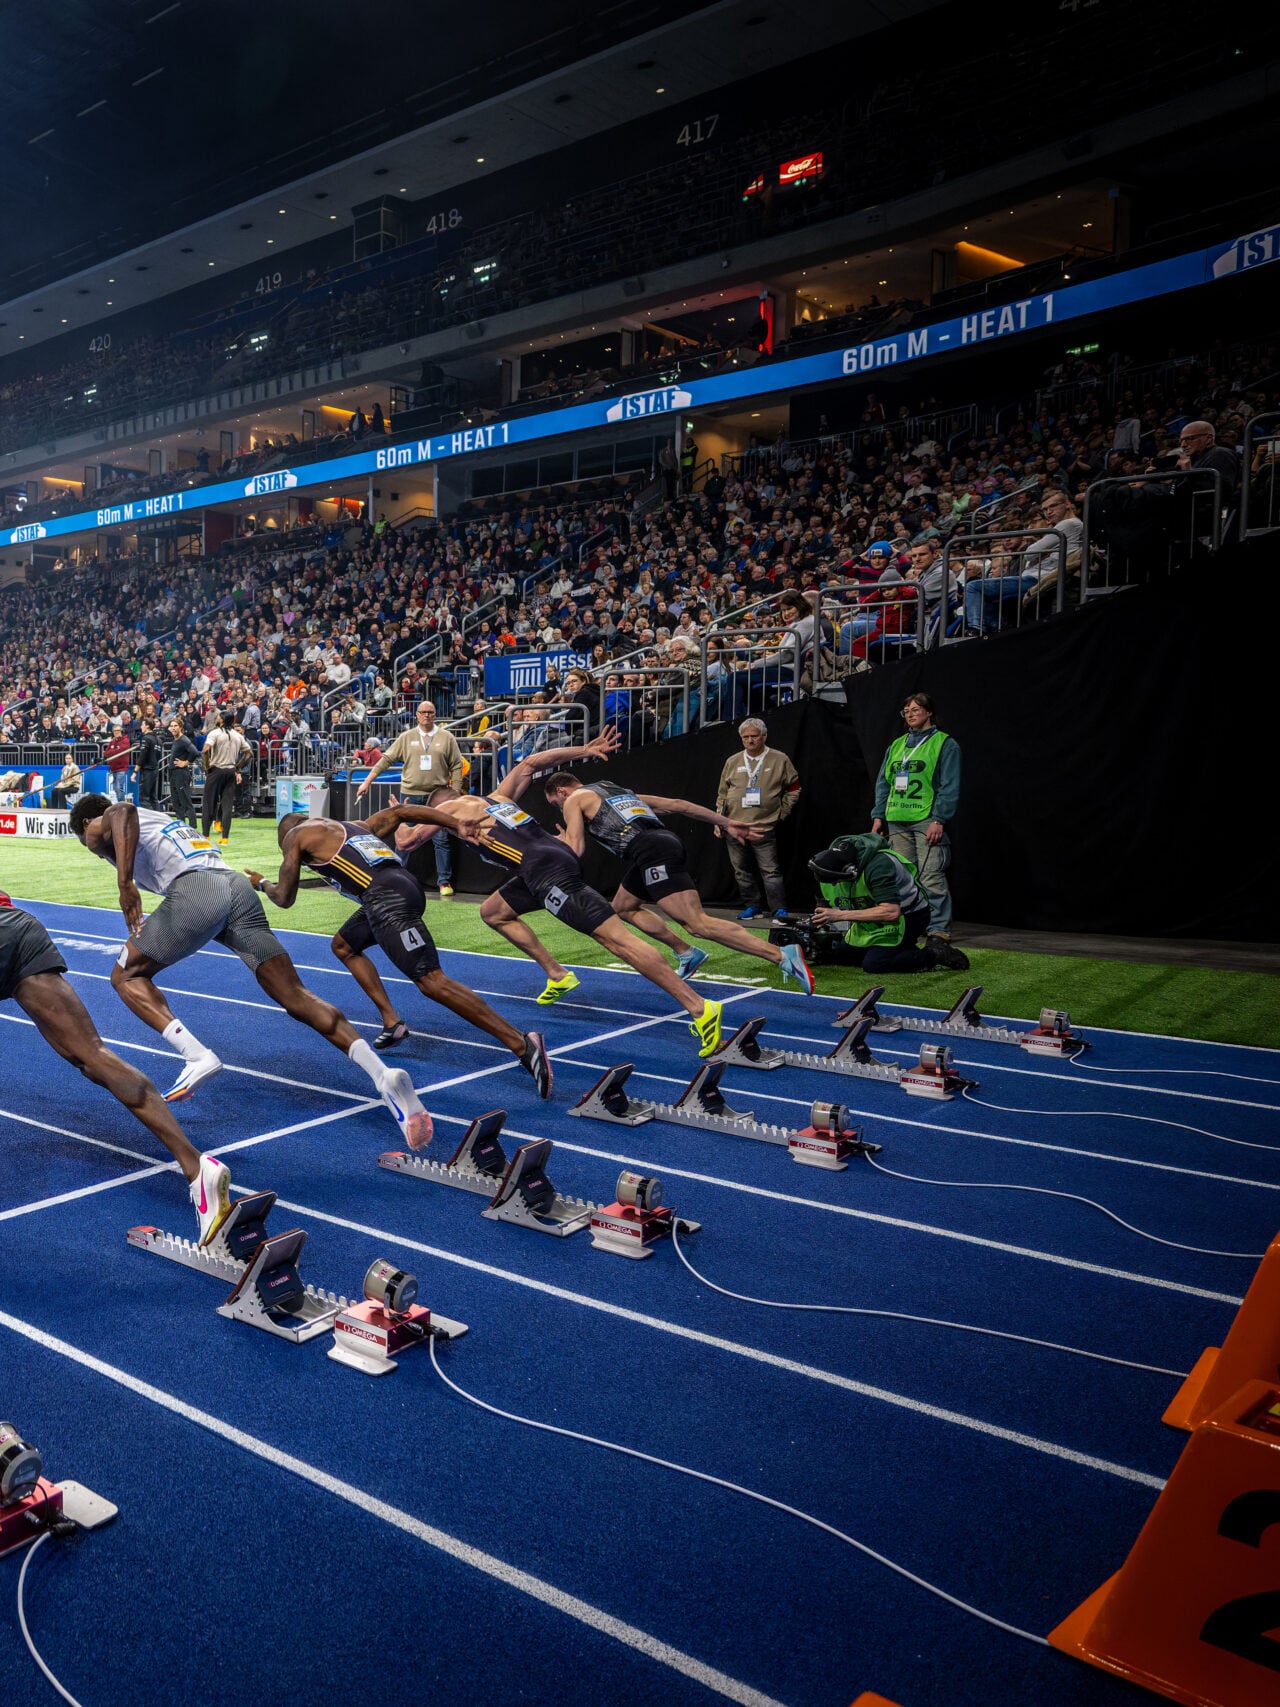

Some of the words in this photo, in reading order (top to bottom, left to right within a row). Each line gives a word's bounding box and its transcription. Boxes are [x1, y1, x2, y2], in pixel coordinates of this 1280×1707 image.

[676, 113, 720, 148] 417
[426, 208, 460, 236] 418
[254, 271, 283, 295] 419
[88, 332, 112, 353] 420
[842, 341, 898, 375] 60m
[907, 329, 928, 359] M
[961, 301, 1032, 345] HEAT
[1043, 294, 1055, 322] 1
[621, 388, 676, 420] ISTAF
[376, 446, 412, 470] 60m
[417, 440, 431, 462] M
[451, 426, 495, 455] HEAT
[501, 422, 510, 444] 1
[253, 472, 289, 495] ISTAF
[96, 508, 121, 527] 60m
[124, 504, 133, 520] M
[145, 495, 174, 516] HEAT
[177, 493, 183, 510] 1
[16, 524, 40, 542] ISTAF
[25, 816, 45, 835] Wir
[650, 868, 660, 881] 6
[548, 892, 562, 907] 5
[408, 930, 419, 947] 4
[1033, 1040, 1055, 1048] OMEGA
[913, 1079, 936, 1087] OMEGA
[803, 1142, 828, 1153] OMEGA
[607, 1223, 633, 1235] OMEGA
[277, 1275, 291, 1286] OMEGA
[351, 1327, 378, 1343] OMEGA
